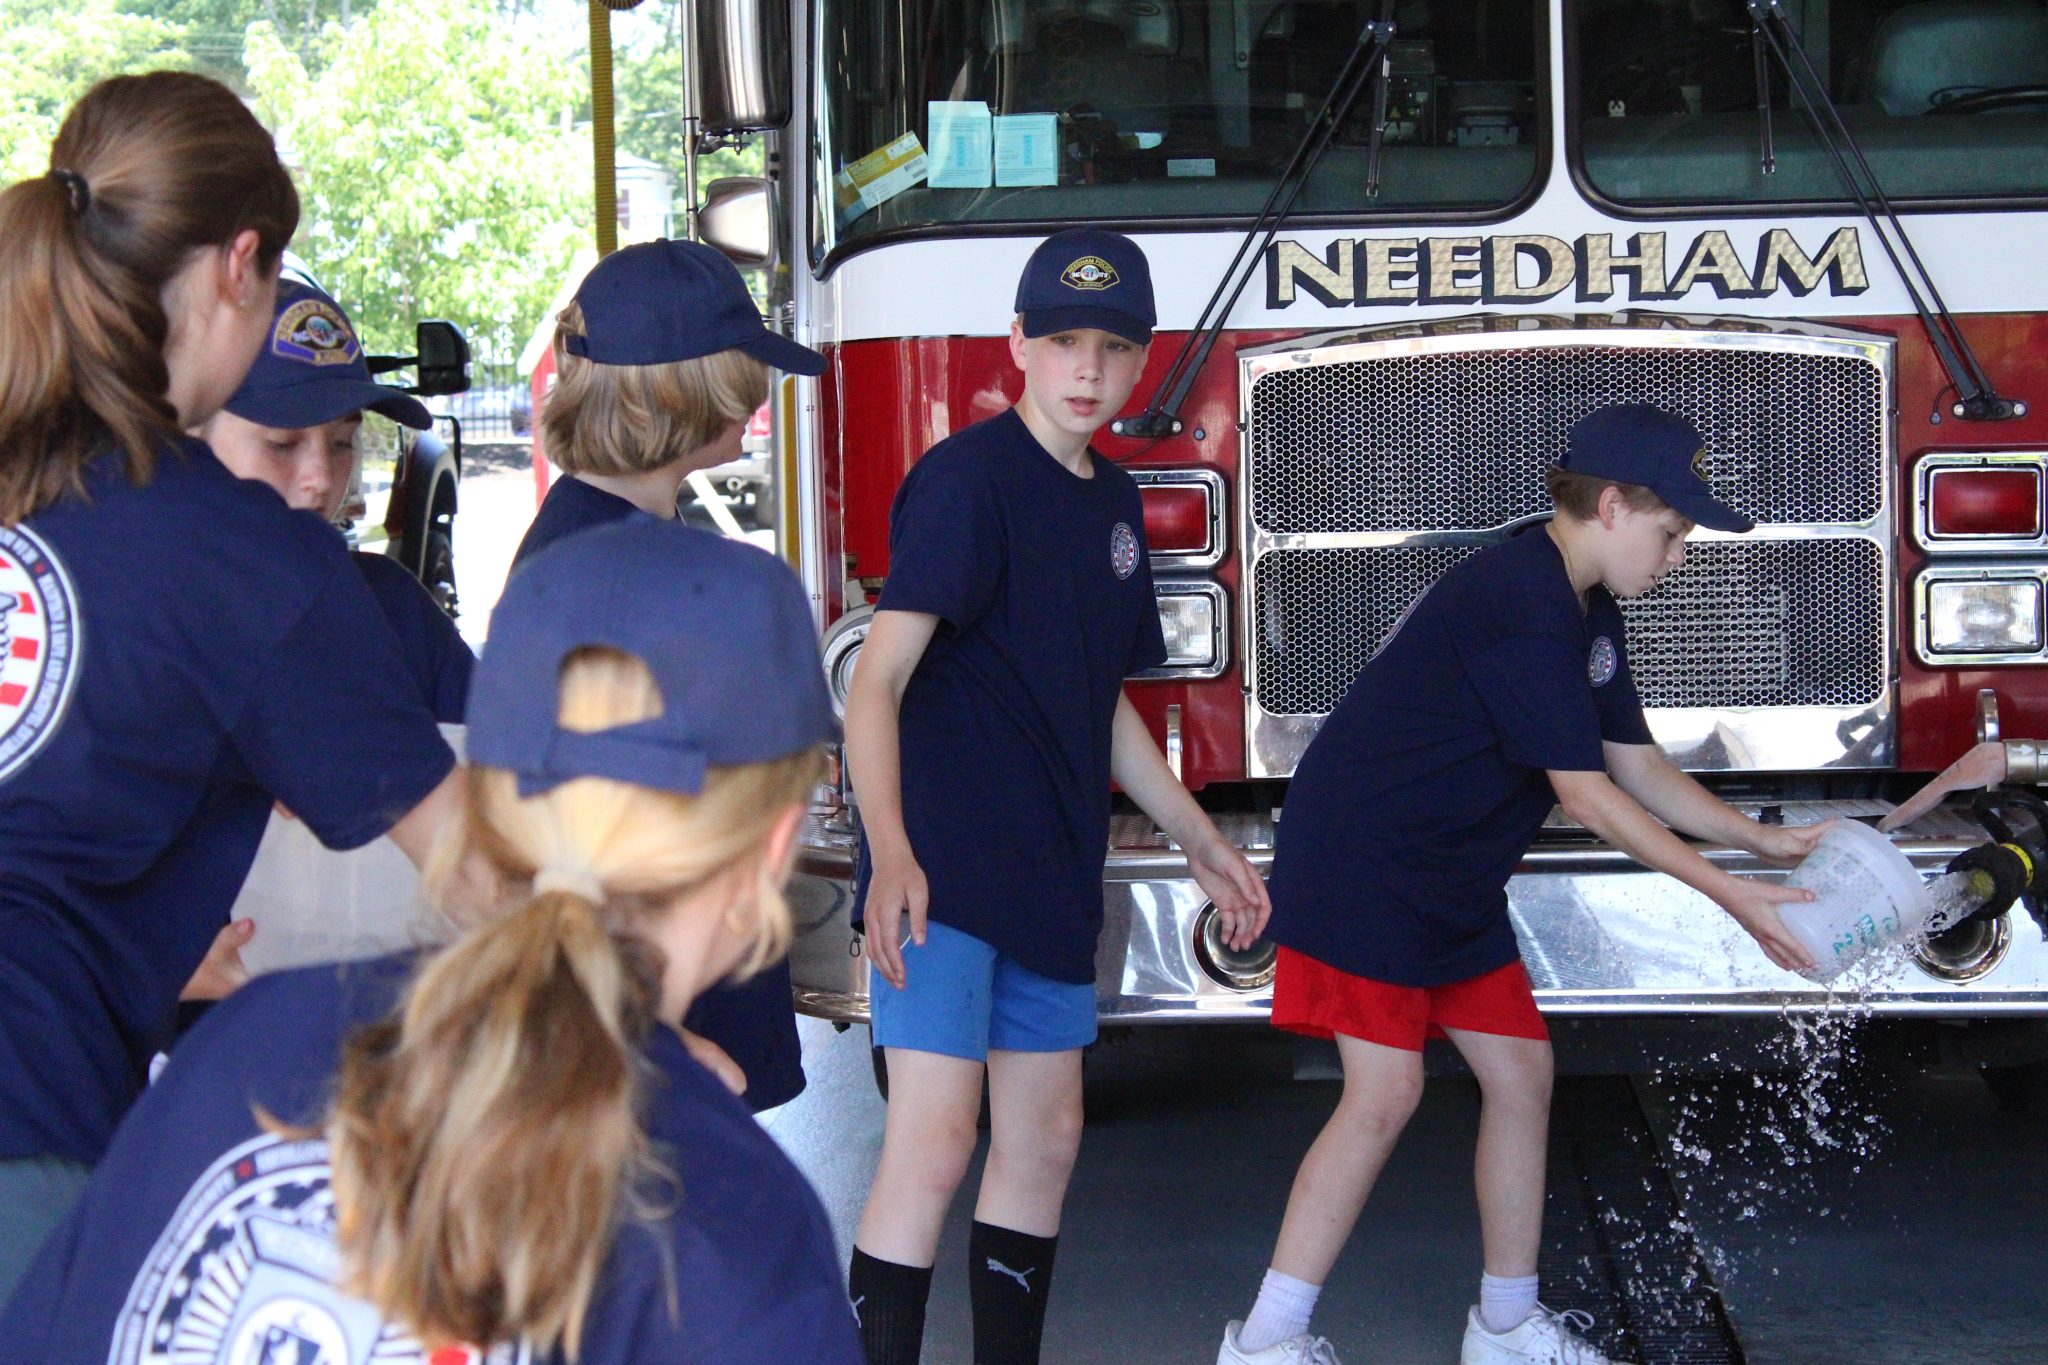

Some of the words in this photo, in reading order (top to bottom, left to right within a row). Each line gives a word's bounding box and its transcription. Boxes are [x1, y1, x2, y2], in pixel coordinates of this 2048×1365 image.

[1067, 258, 1094, 273] NEEDHAM
[1095, 258, 1114, 274] POLICE
[1266, 227, 1869, 309] NEEDHAM
